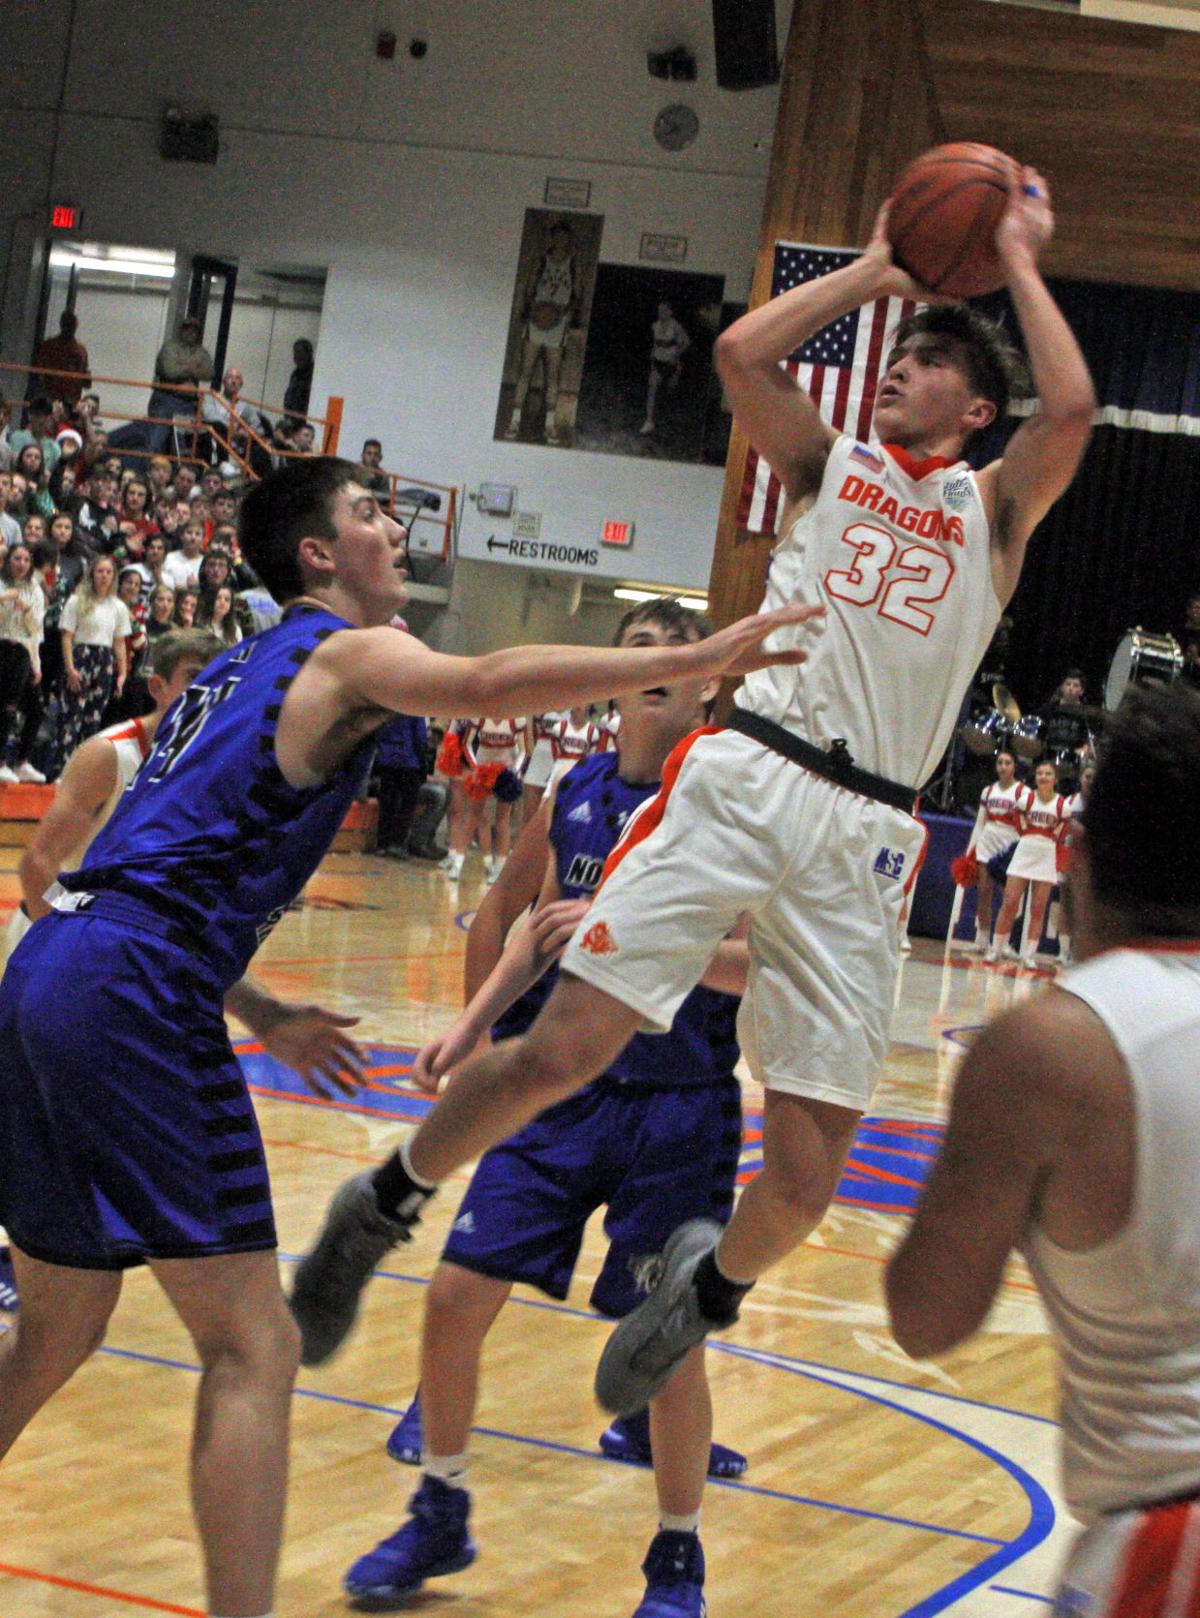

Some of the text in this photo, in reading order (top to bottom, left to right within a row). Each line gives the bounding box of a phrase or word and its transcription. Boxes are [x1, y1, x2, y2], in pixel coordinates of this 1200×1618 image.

[52, 206, 75, 228] EXIT
[838, 475, 964, 547] DRAGONS
[603, 520, 629, 543] EXIT
[508, 539, 599, 566] RESTROOMS
[824, 522, 955, 637] 32
